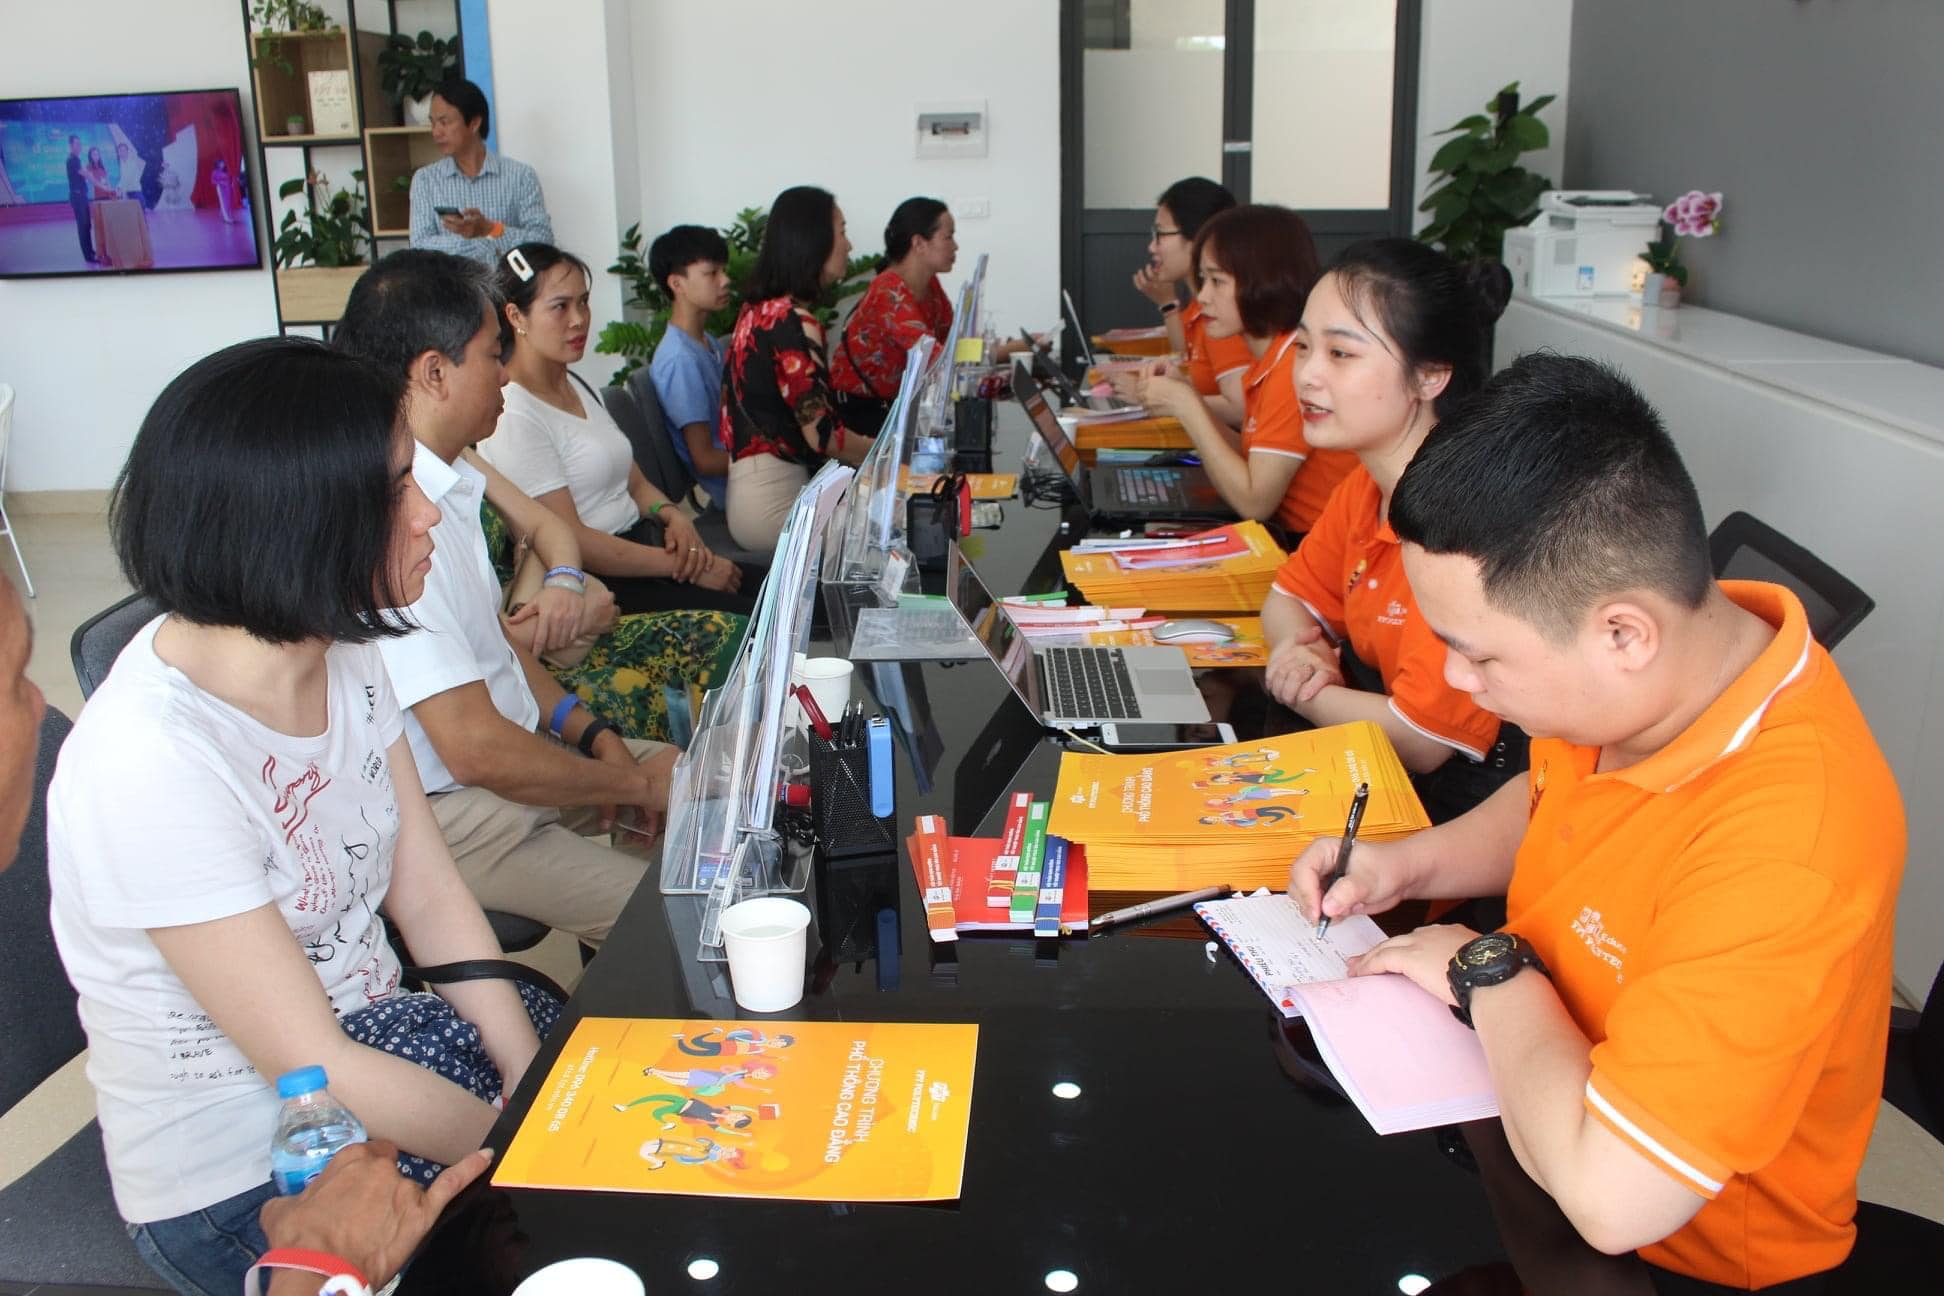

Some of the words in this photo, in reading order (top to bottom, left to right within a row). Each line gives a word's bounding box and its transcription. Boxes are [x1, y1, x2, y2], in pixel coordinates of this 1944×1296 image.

[848, 1039, 870, 1062] PHỔ
[839, 1063, 862, 1101] THÔNG
[861, 1057, 885, 1105] CHƯƠNG
[832, 1102, 853, 1127] CAO
[855, 1106, 877, 1142] TRÌNH
[824, 1128, 854, 1164] ĐẲNG
